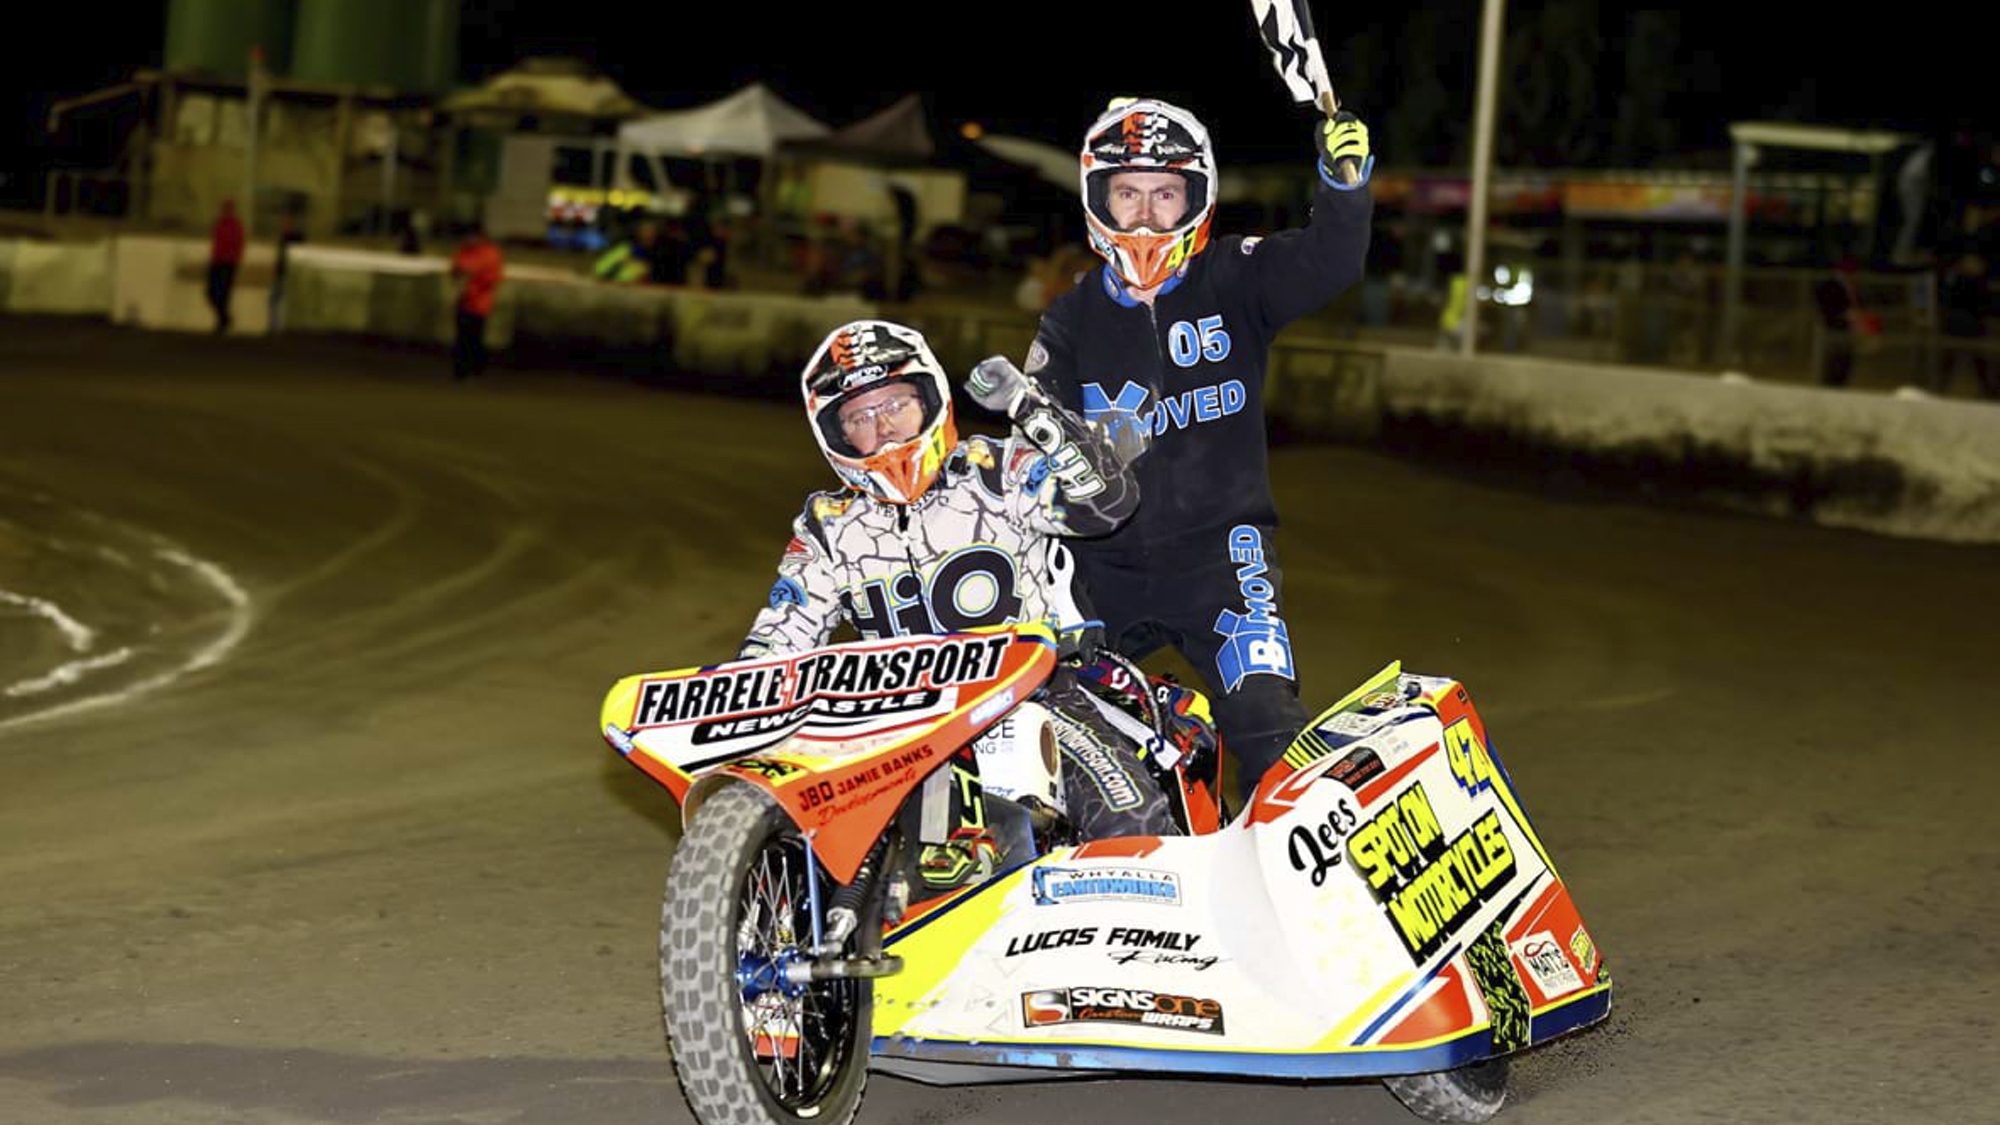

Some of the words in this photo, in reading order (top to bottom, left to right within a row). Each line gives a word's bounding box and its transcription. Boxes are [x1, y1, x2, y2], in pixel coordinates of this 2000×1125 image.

[1168, 314, 1231, 368] 05
[838, 545, 1025, 638] HiQ
[1228, 524, 1280, 626] MOVED
[636, 668, 786, 726] FARRELL
[794, 636, 1010, 702] TRANSPORT
[707, 690, 929, 739] NEWCASTLE
[797, 780, 835, 812] JBD
[837, 768, 882, 796] JAMIE
[881, 744, 935, 777] BANKS
[1287, 798, 1357, 888] Lees
[1397, 780, 1444, 851] ON
[1050, 877, 1178, 899] EARTHWORKS
[1069, 870, 1173, 882] WHYALLA
[1386, 807, 1517, 960] MOTORCYCLES
[1005, 926, 1098, 958] LUCAS
[1106, 926, 1201, 952] FAMILY
[1141, 1010, 1214, 1030] WRAPS
